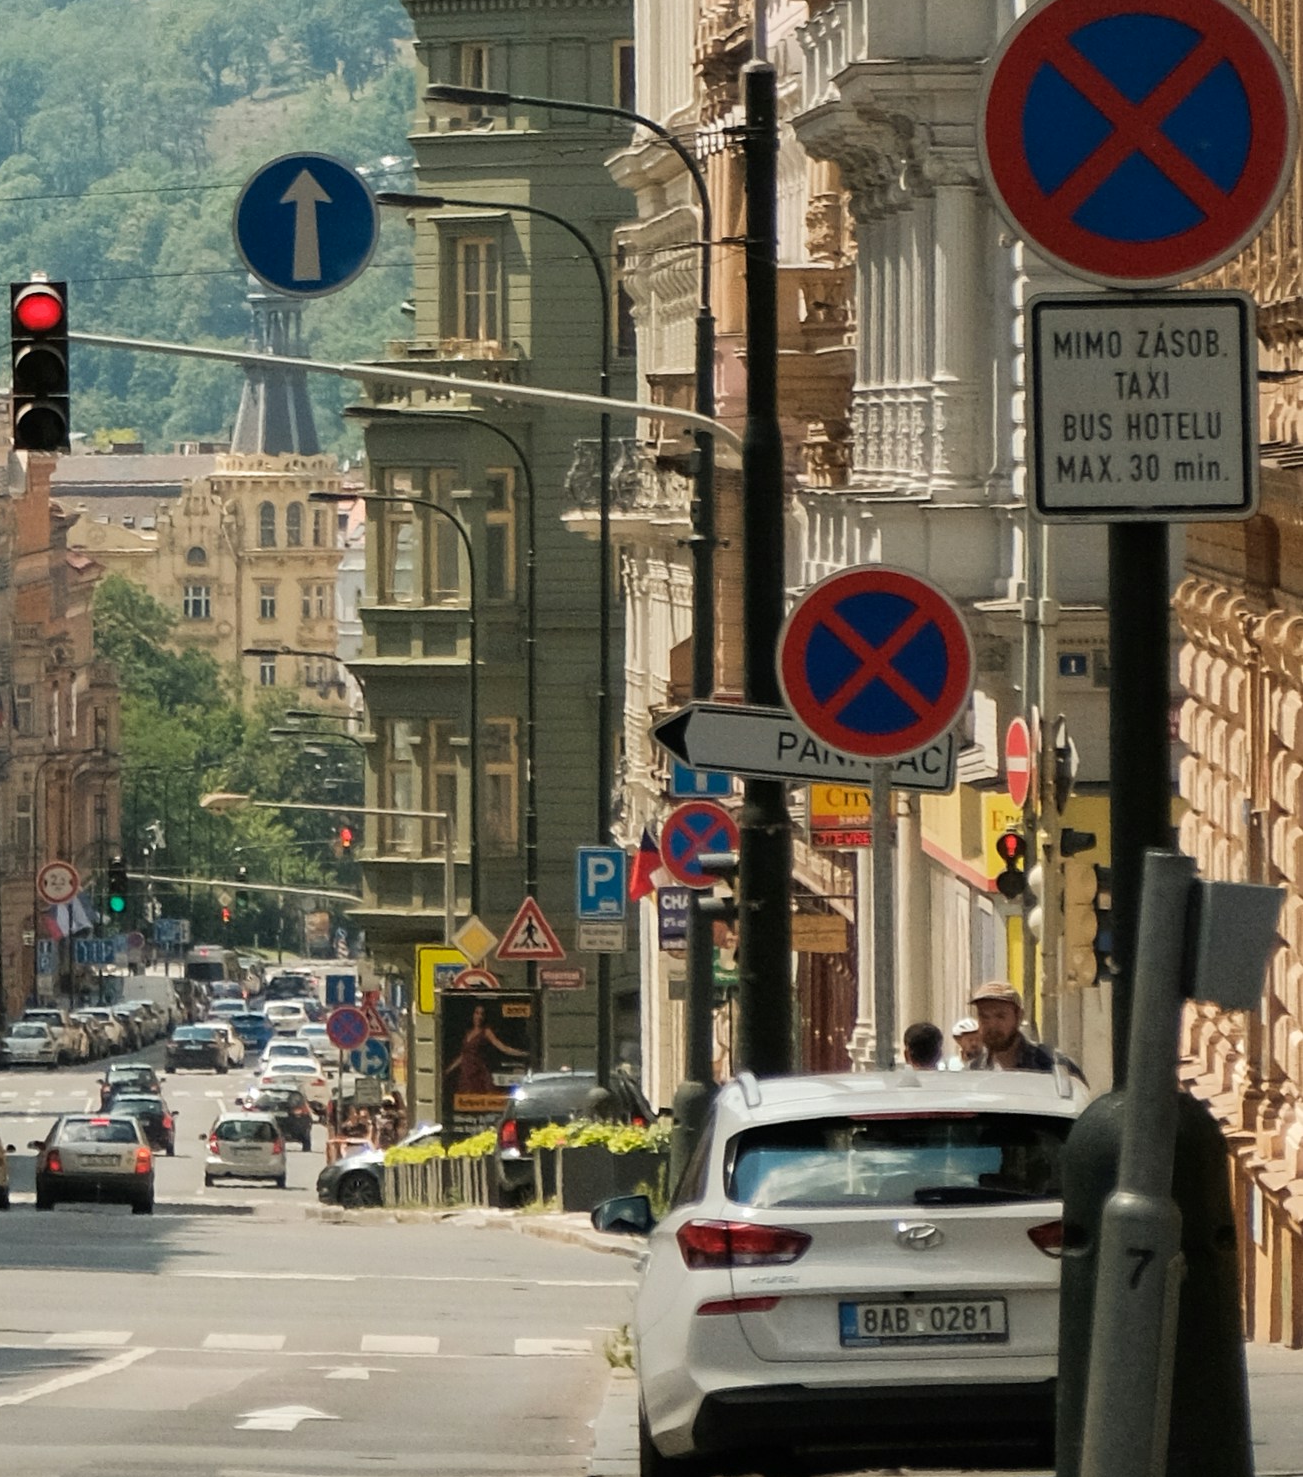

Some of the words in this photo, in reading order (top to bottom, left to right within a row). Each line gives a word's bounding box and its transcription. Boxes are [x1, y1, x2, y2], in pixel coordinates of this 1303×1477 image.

[1053, 330, 1122, 360] MIMO
[1137, 321, 1228, 359] ZÁSOB.
[1115, 371, 1170, 400] TAXI
[1063, 412, 1113, 442] BUS
[1127, 410, 1222, 442] HOTELU
[1057, 454, 1122, 483] MAX.
[1130, 453, 1160, 482] 30
[1174, 453, 1230, 482] min.
[587, 856, 616, 897] P
[1126, 1247, 1155, 1290] 7
[864, 1307, 910, 1334] 8AB
[930, 1305, 993, 1332] 0281
